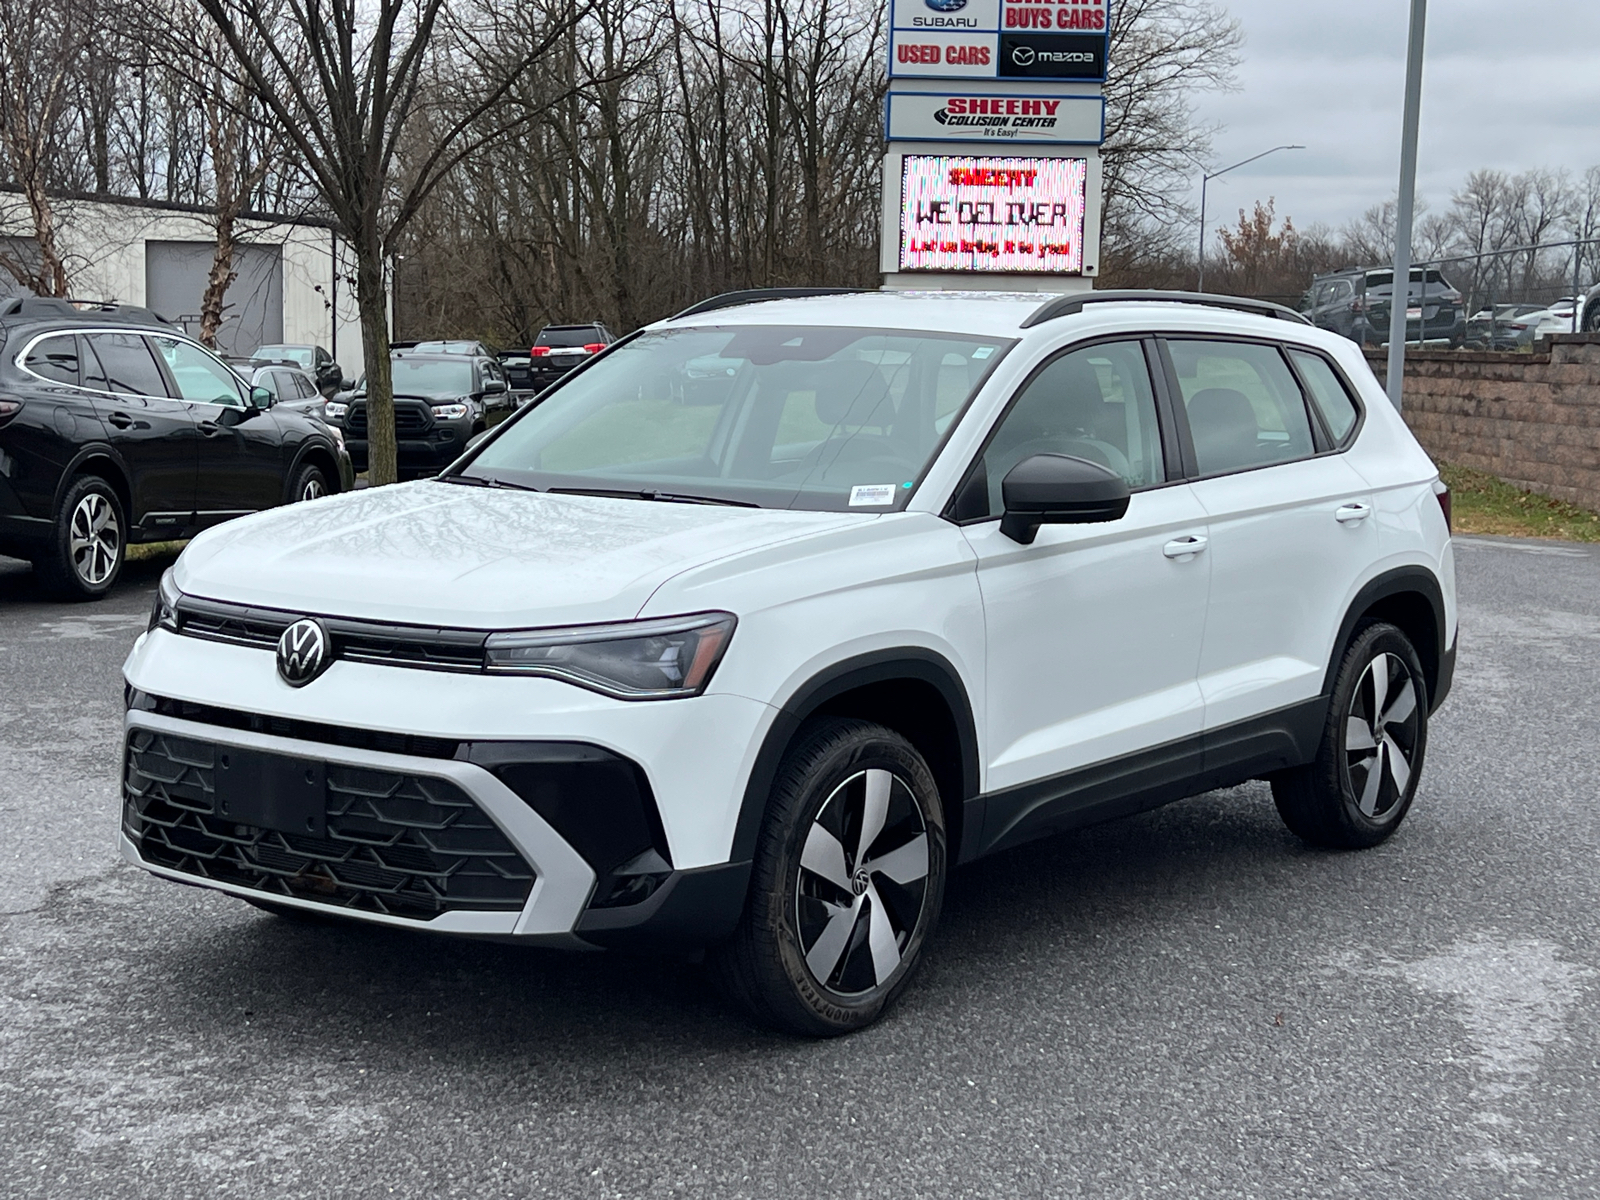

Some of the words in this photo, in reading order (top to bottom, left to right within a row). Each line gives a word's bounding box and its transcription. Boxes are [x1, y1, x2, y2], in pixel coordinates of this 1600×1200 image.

[912, 16, 978, 28] SUBARU
[1005, 7, 1052, 29] BUYS
[1057, 8, 1105, 30] CARS
[897, 44, 941, 64] USED
[945, 45, 990, 65] CARS
[947, 98, 1061, 115] SHEEHY
[947, 116, 1010, 127] COLLISION
[1011, 117, 1057, 128] CENTER
[997, 128, 1018, 138] Easy!
[917, 201, 951, 224] WE
[959, 201, 1067, 225] DELIVER
